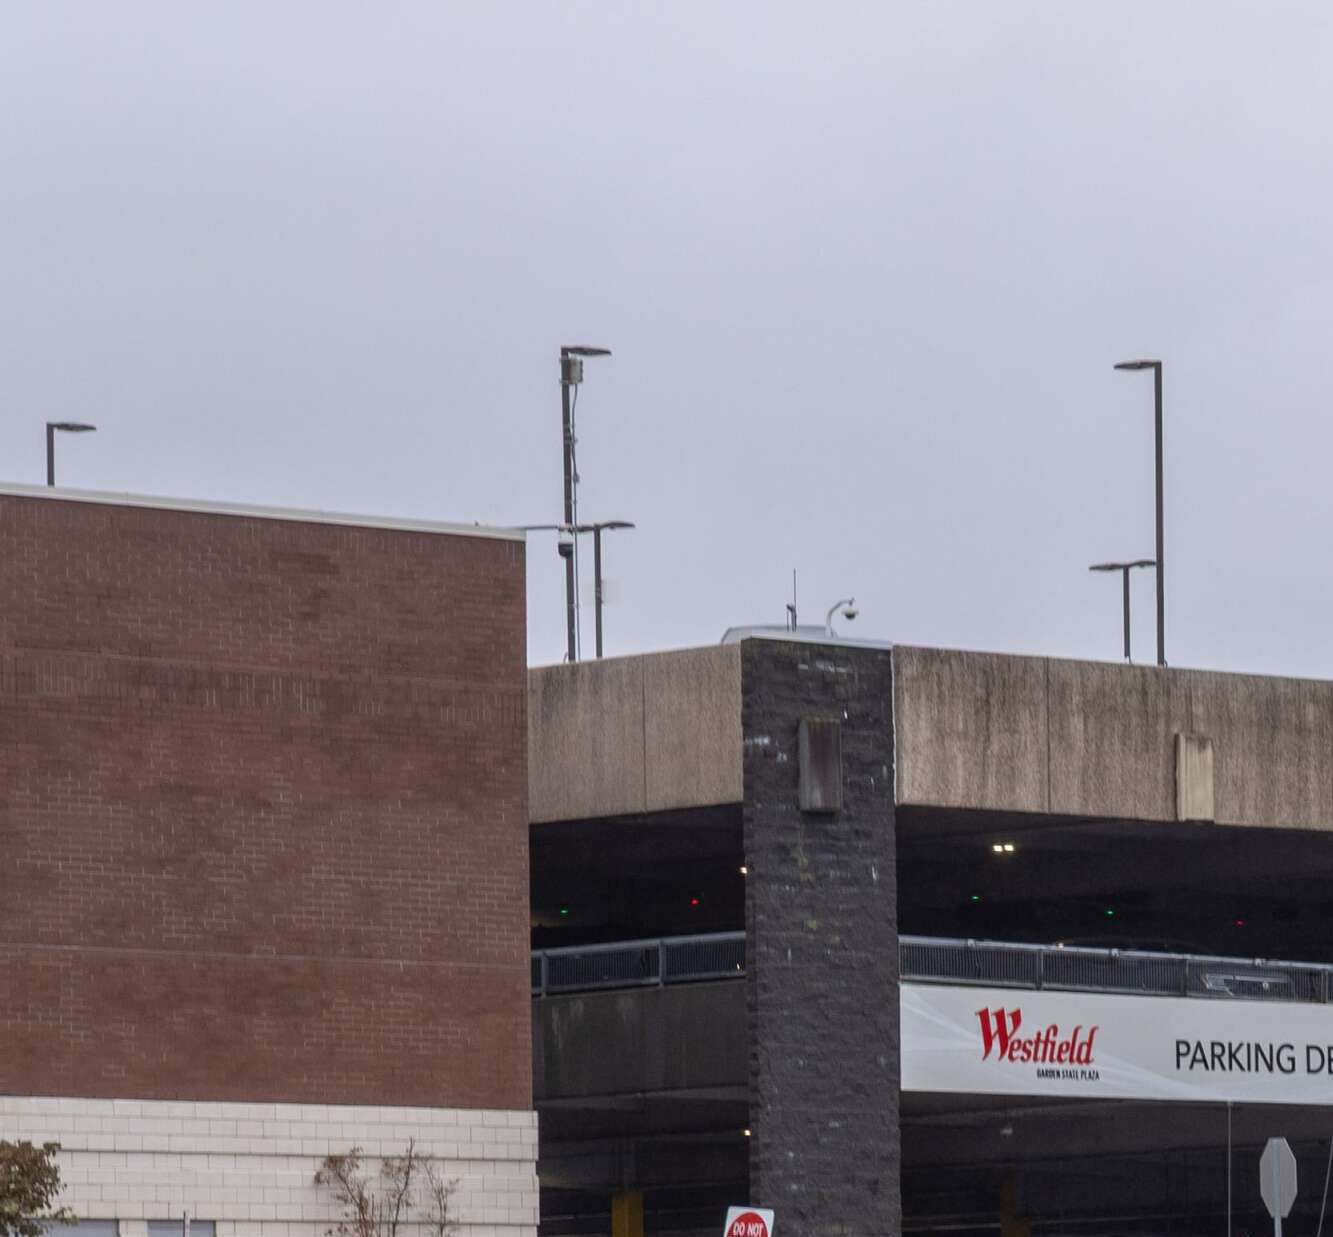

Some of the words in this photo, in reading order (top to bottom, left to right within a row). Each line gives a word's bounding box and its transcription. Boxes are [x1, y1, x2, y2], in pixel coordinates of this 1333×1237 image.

[974, 1006, 1099, 1066] Westfield
[1175, 1040, 1296, 1075] PARKING
[1036, 1068, 1061, 1079] GARDEN
[1061, 1069, 1079, 1080] STATE
[1080, 1070, 1100, 1080] PLAZA
[732, 1221, 746, 1236] DO
[747, 1222, 764, 1237] NOT
